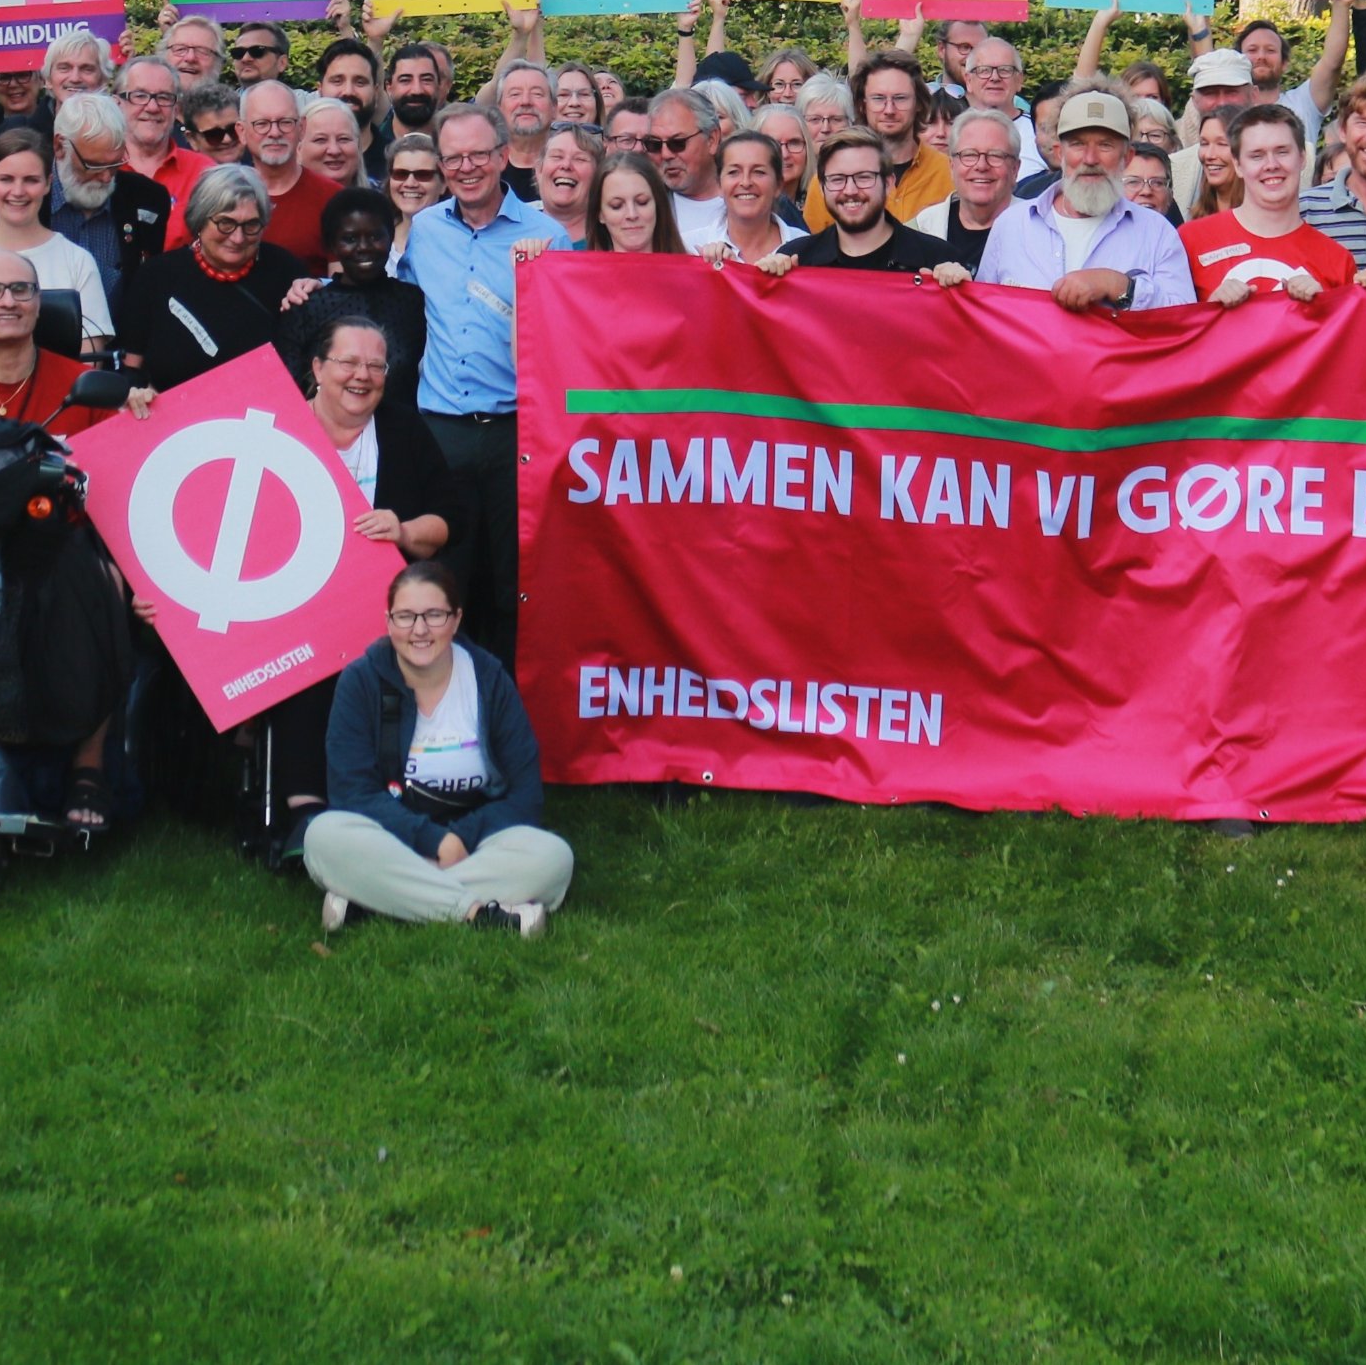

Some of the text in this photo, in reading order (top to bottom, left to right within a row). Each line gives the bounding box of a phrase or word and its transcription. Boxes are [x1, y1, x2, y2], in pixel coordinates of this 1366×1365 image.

[128, 408, 345, 634] Ø
[569, 438, 852, 515] SAMMEN
[881, 455, 1010, 528] KAN
[1037, 470, 1094, 539] VI
[1117, 464, 1325, 535] GØRE
[222, 644, 314, 700] ENHEDSLISTEN
[579, 666, 942, 746] ENHEDSLISTEN
